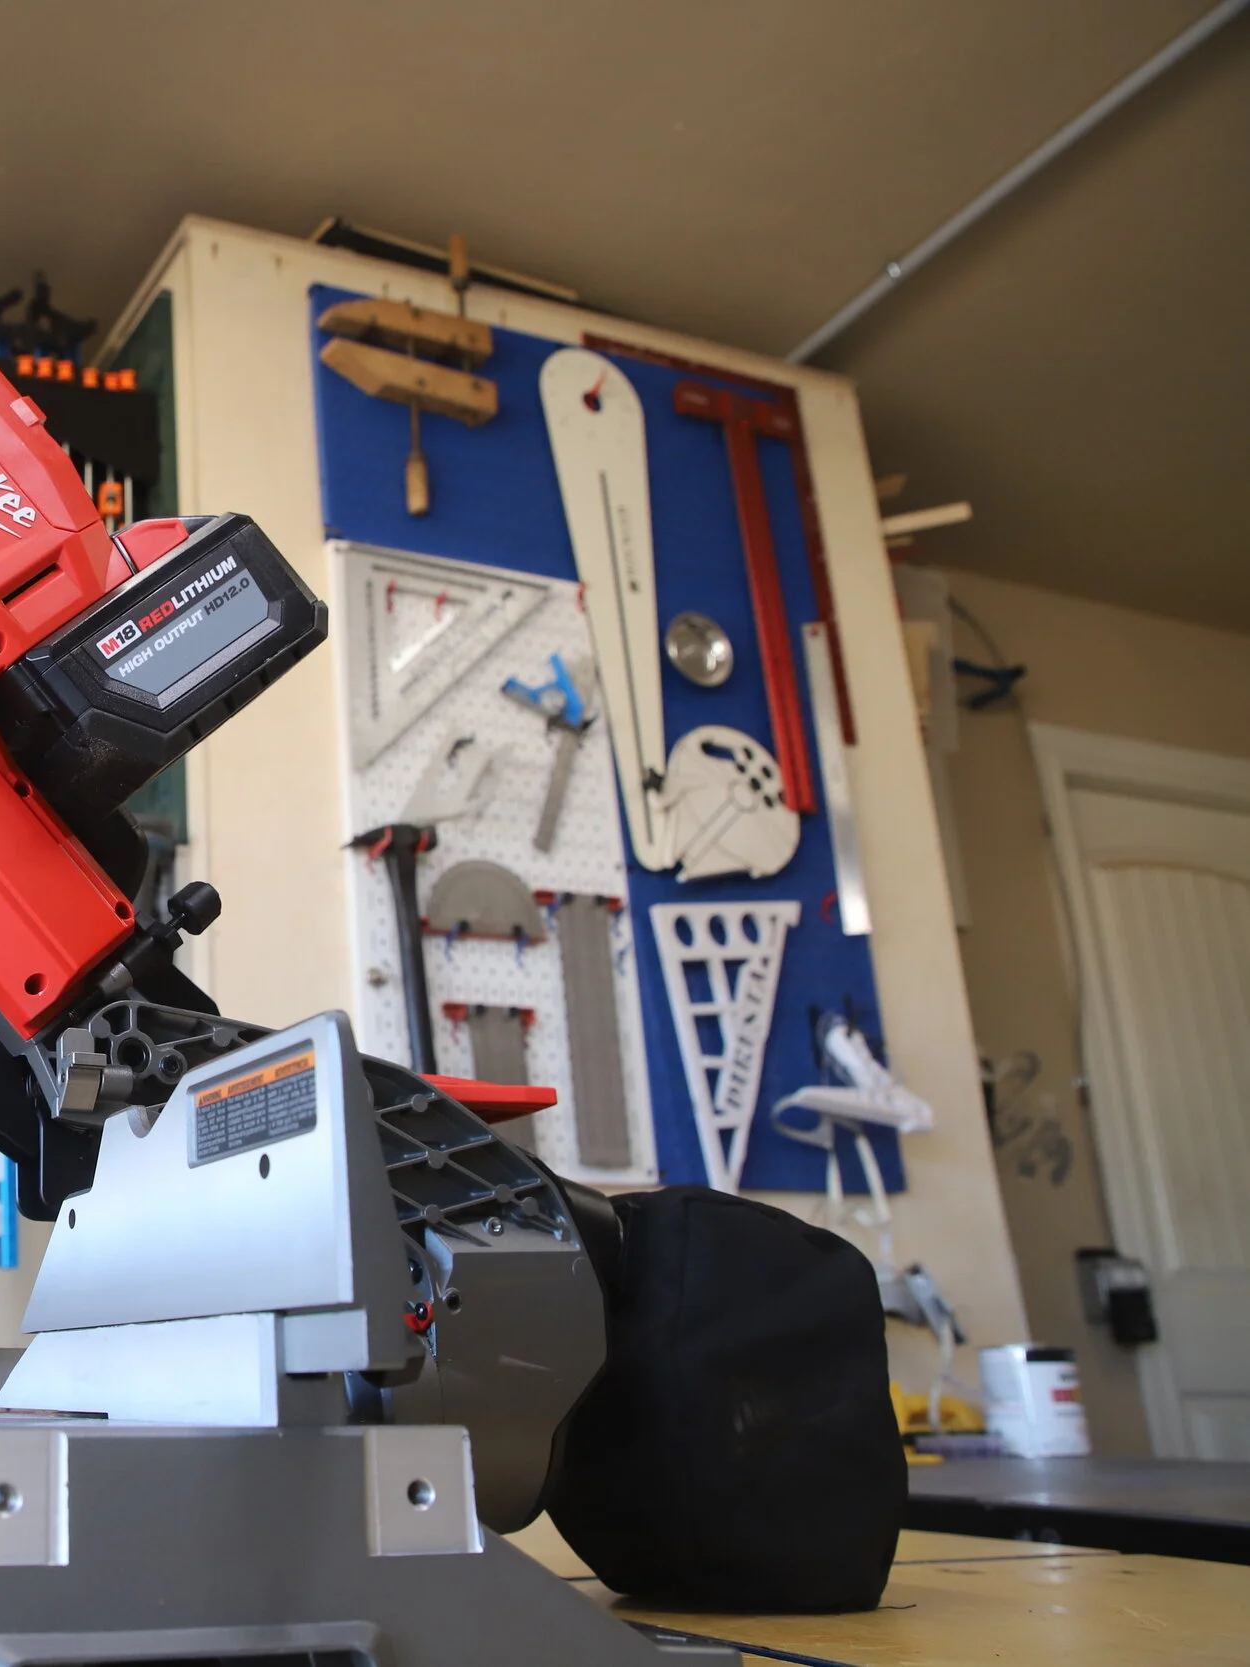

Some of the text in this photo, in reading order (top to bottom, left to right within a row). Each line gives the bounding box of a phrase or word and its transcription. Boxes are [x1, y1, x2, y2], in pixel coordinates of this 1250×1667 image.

[101, 555, 237, 656] M18 REDLITHIUM
[118, 577, 250, 678] HIGH OUTPUT HD12.0
